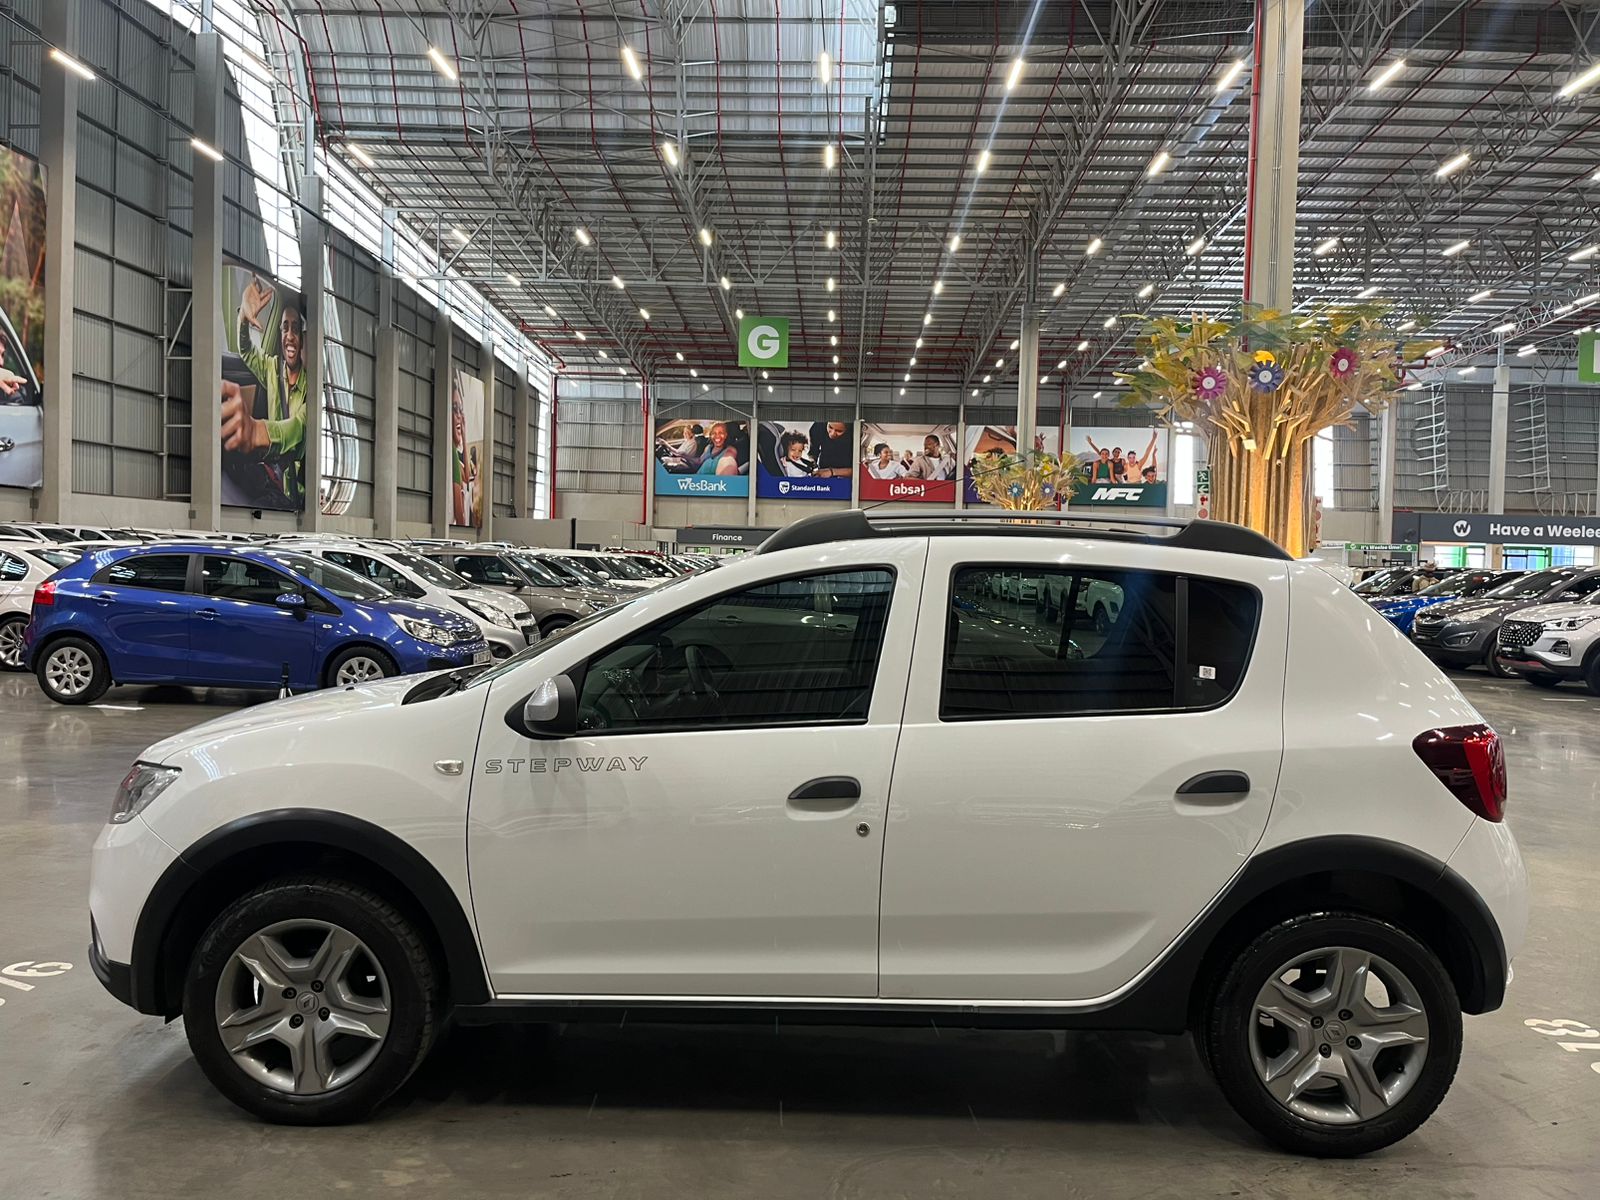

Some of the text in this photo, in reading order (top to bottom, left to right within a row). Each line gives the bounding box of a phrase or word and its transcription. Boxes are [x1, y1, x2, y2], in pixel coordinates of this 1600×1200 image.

[747, 324, 780, 360] G
[677, 477, 727, 492] WesBank
[791, 484, 831, 493] Standard Bank
[1091, 487, 1144, 501] MFC
[1489, 523, 1530, 537] Have
[1533, 525, 1544, 537] a
[712, 533, 743, 542] Finance
[485, 756, 648, 774] STEPWAY
